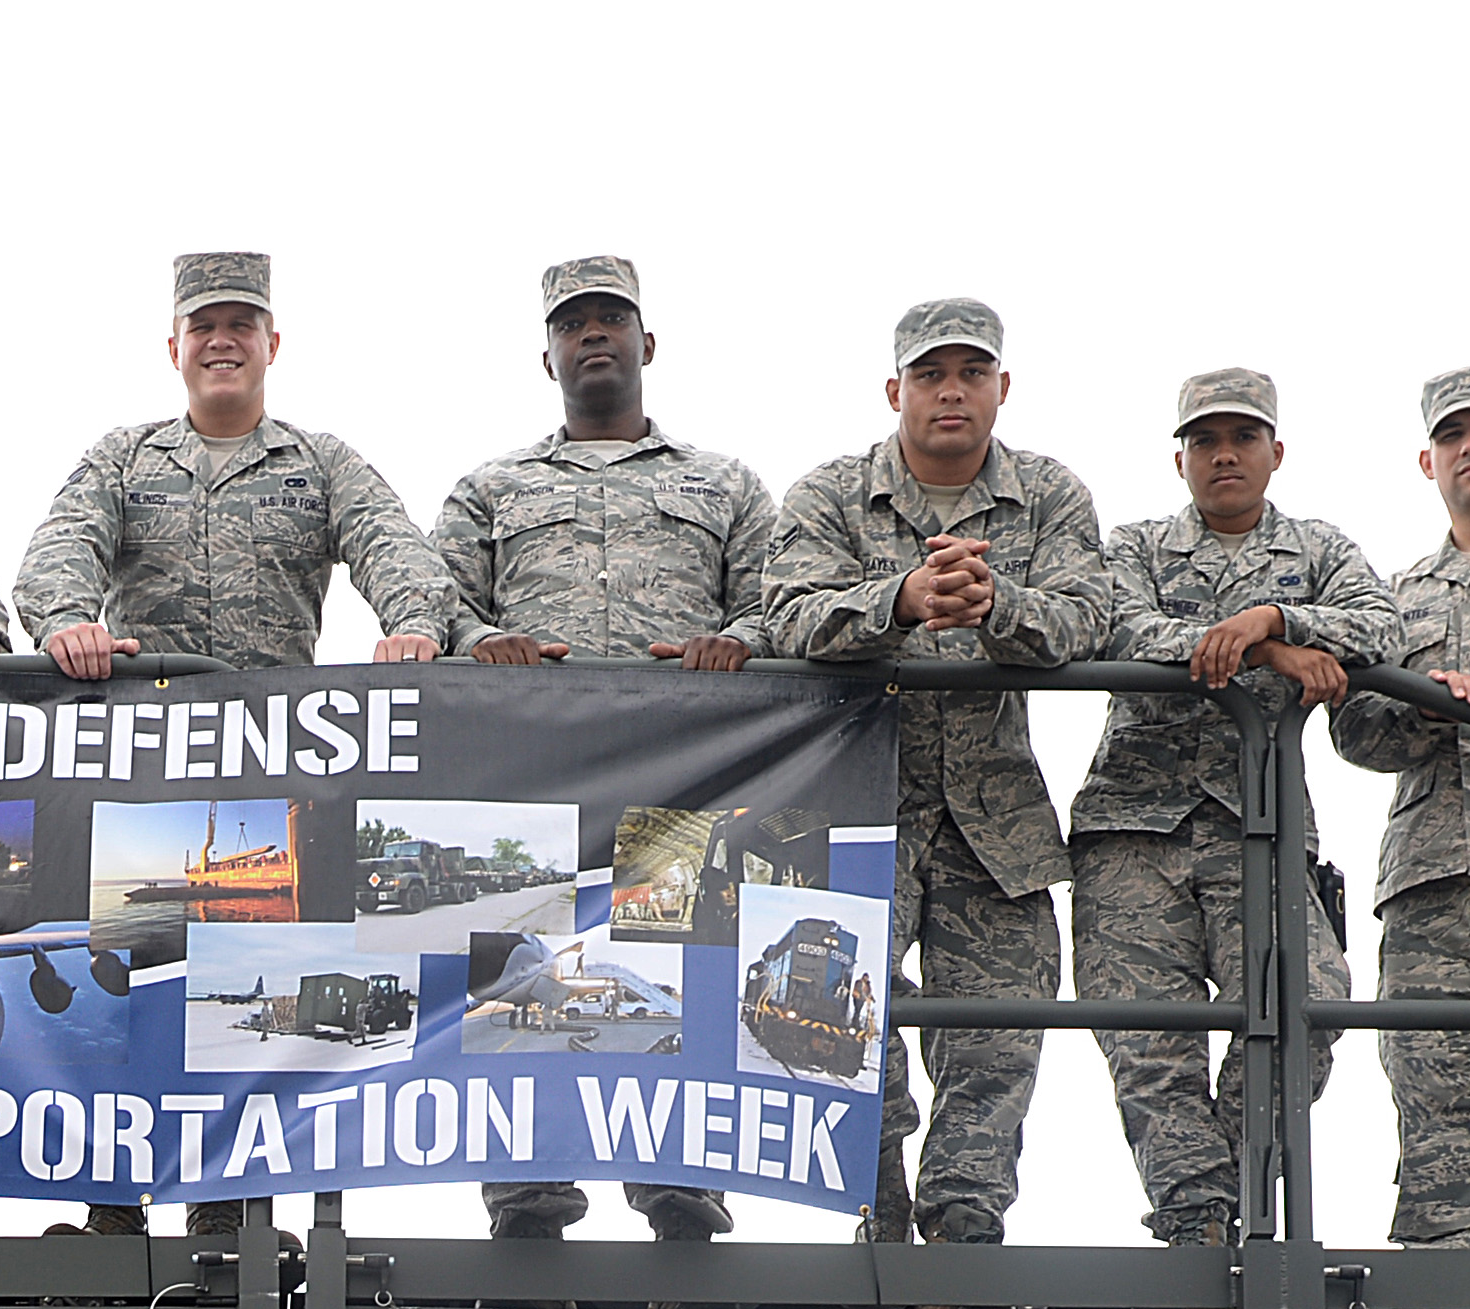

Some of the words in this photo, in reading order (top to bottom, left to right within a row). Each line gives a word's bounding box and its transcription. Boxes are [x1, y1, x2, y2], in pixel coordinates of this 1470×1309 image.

[259, 497, 276, 508] U.S.
[281, 497, 298, 508] AIR
[580, 1071, 852, 1193] WEEK
